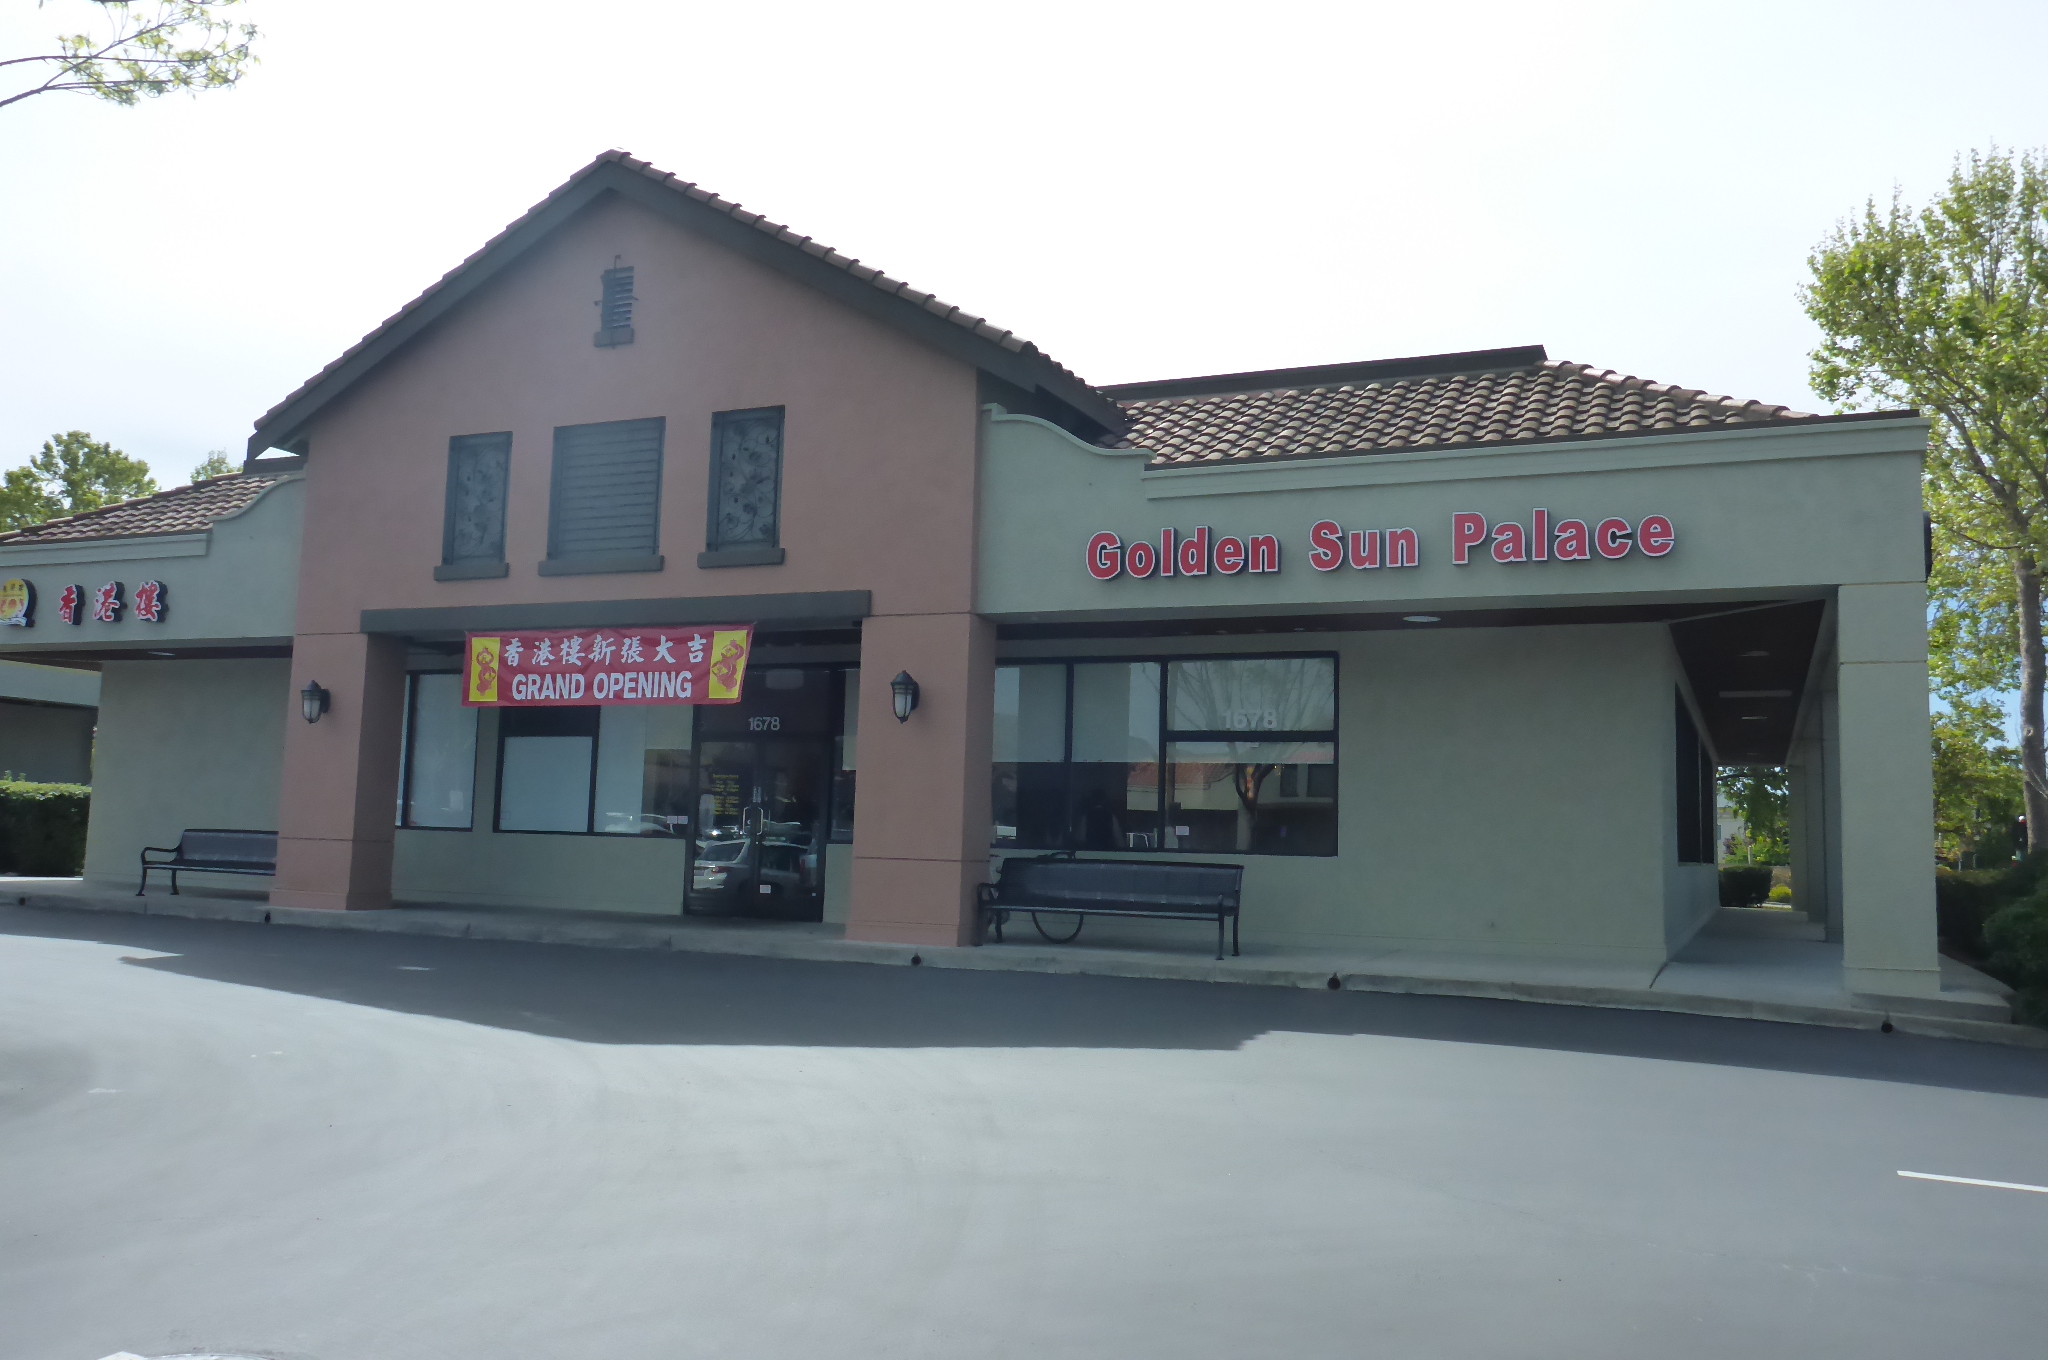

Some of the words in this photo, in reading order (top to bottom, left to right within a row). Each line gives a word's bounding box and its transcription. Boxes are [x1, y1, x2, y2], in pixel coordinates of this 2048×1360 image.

[1085, 526, 1280, 580] Golden
[1308, 519, 1420, 571] Sun
[1451, 507, 1675, 564] Palace
[504, 634, 707, 667] 香港樓新張大吉
[512, 673, 585, 700] GRAND
[593, 670, 693, 699] OPENING
[748, 716, 780, 731] 1678
[1223, 709, 1278, 730] 1678
